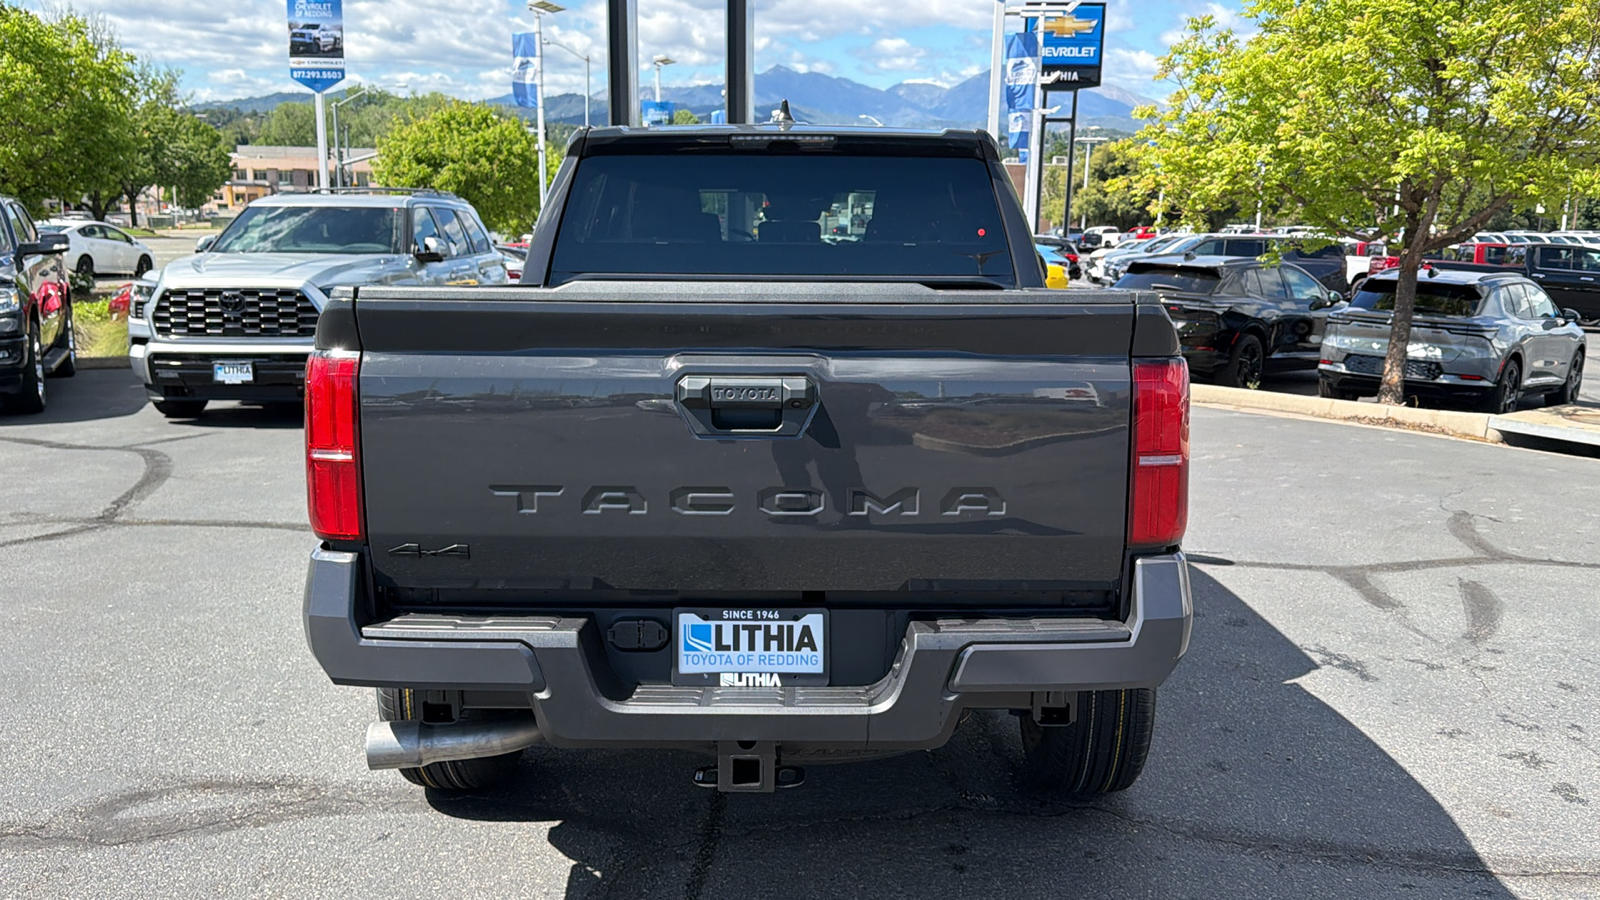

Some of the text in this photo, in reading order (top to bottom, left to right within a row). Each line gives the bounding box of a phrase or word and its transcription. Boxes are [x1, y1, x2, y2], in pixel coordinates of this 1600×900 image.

[714, 388, 779, 400] TOYOTA
[488, 484, 1007, 516] TACOMA
[722, 610, 780, 620] SINCE 1946
[714, 623, 818, 652] LITHIA
[683, 654, 819, 666] TOYOTA OF REDDING
[735, 672, 782, 687] LITHIA
